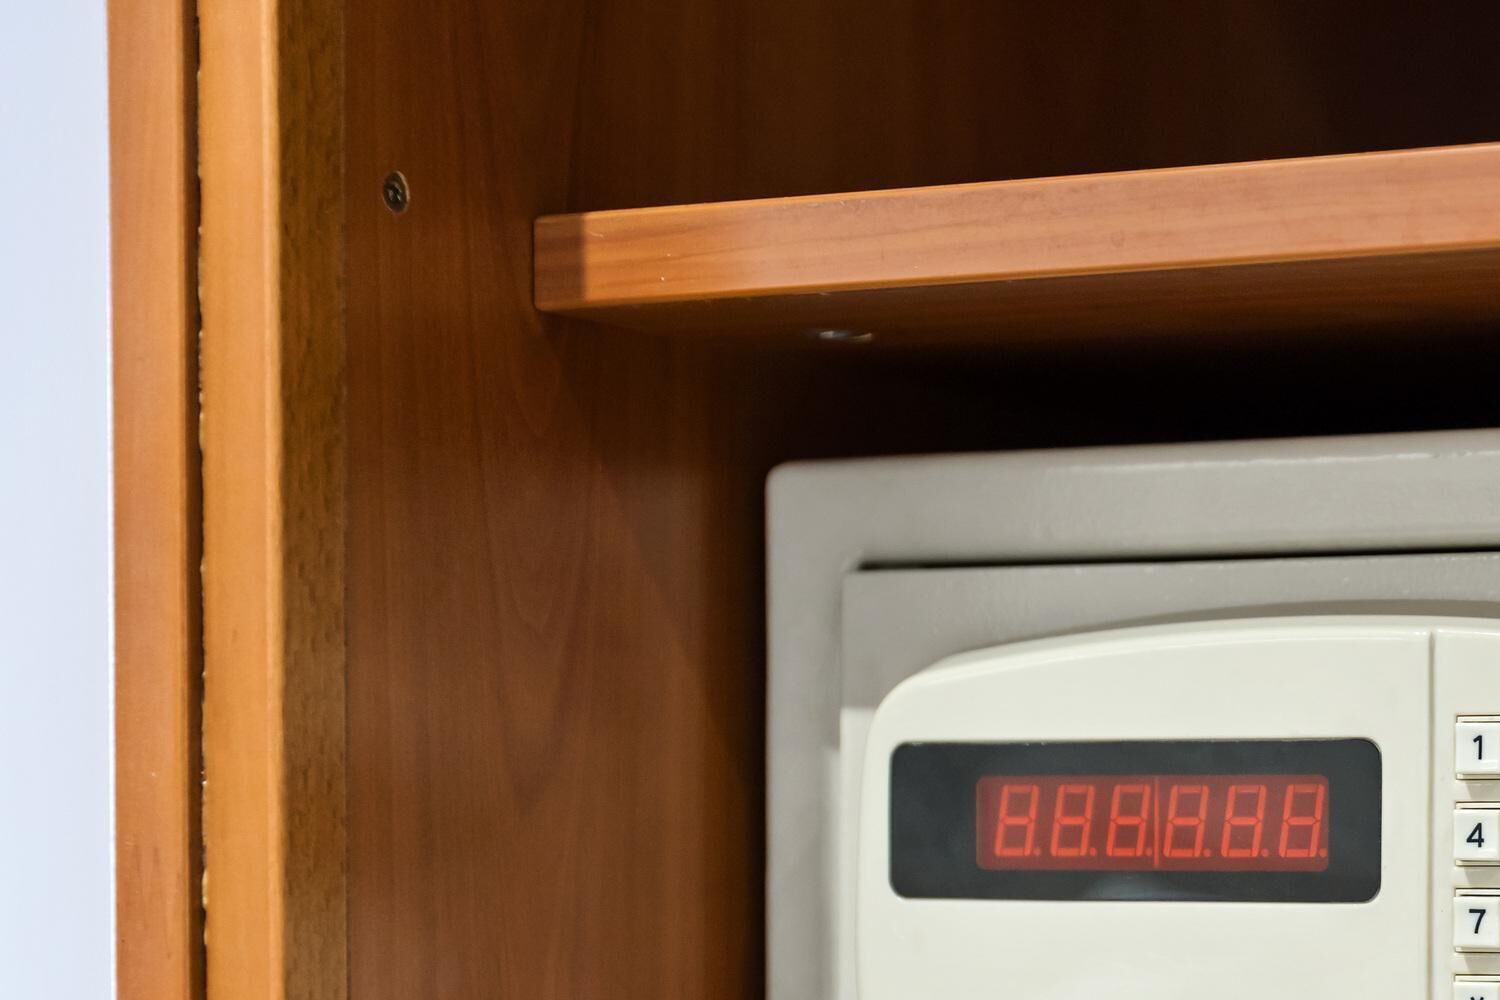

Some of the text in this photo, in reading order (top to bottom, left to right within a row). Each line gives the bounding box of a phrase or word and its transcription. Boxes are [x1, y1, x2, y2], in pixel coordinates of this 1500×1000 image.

[1472, 735, 1483, 760] 1
[1466, 823, 1485, 848] 4
[1468, 909, 1486, 934] 7
